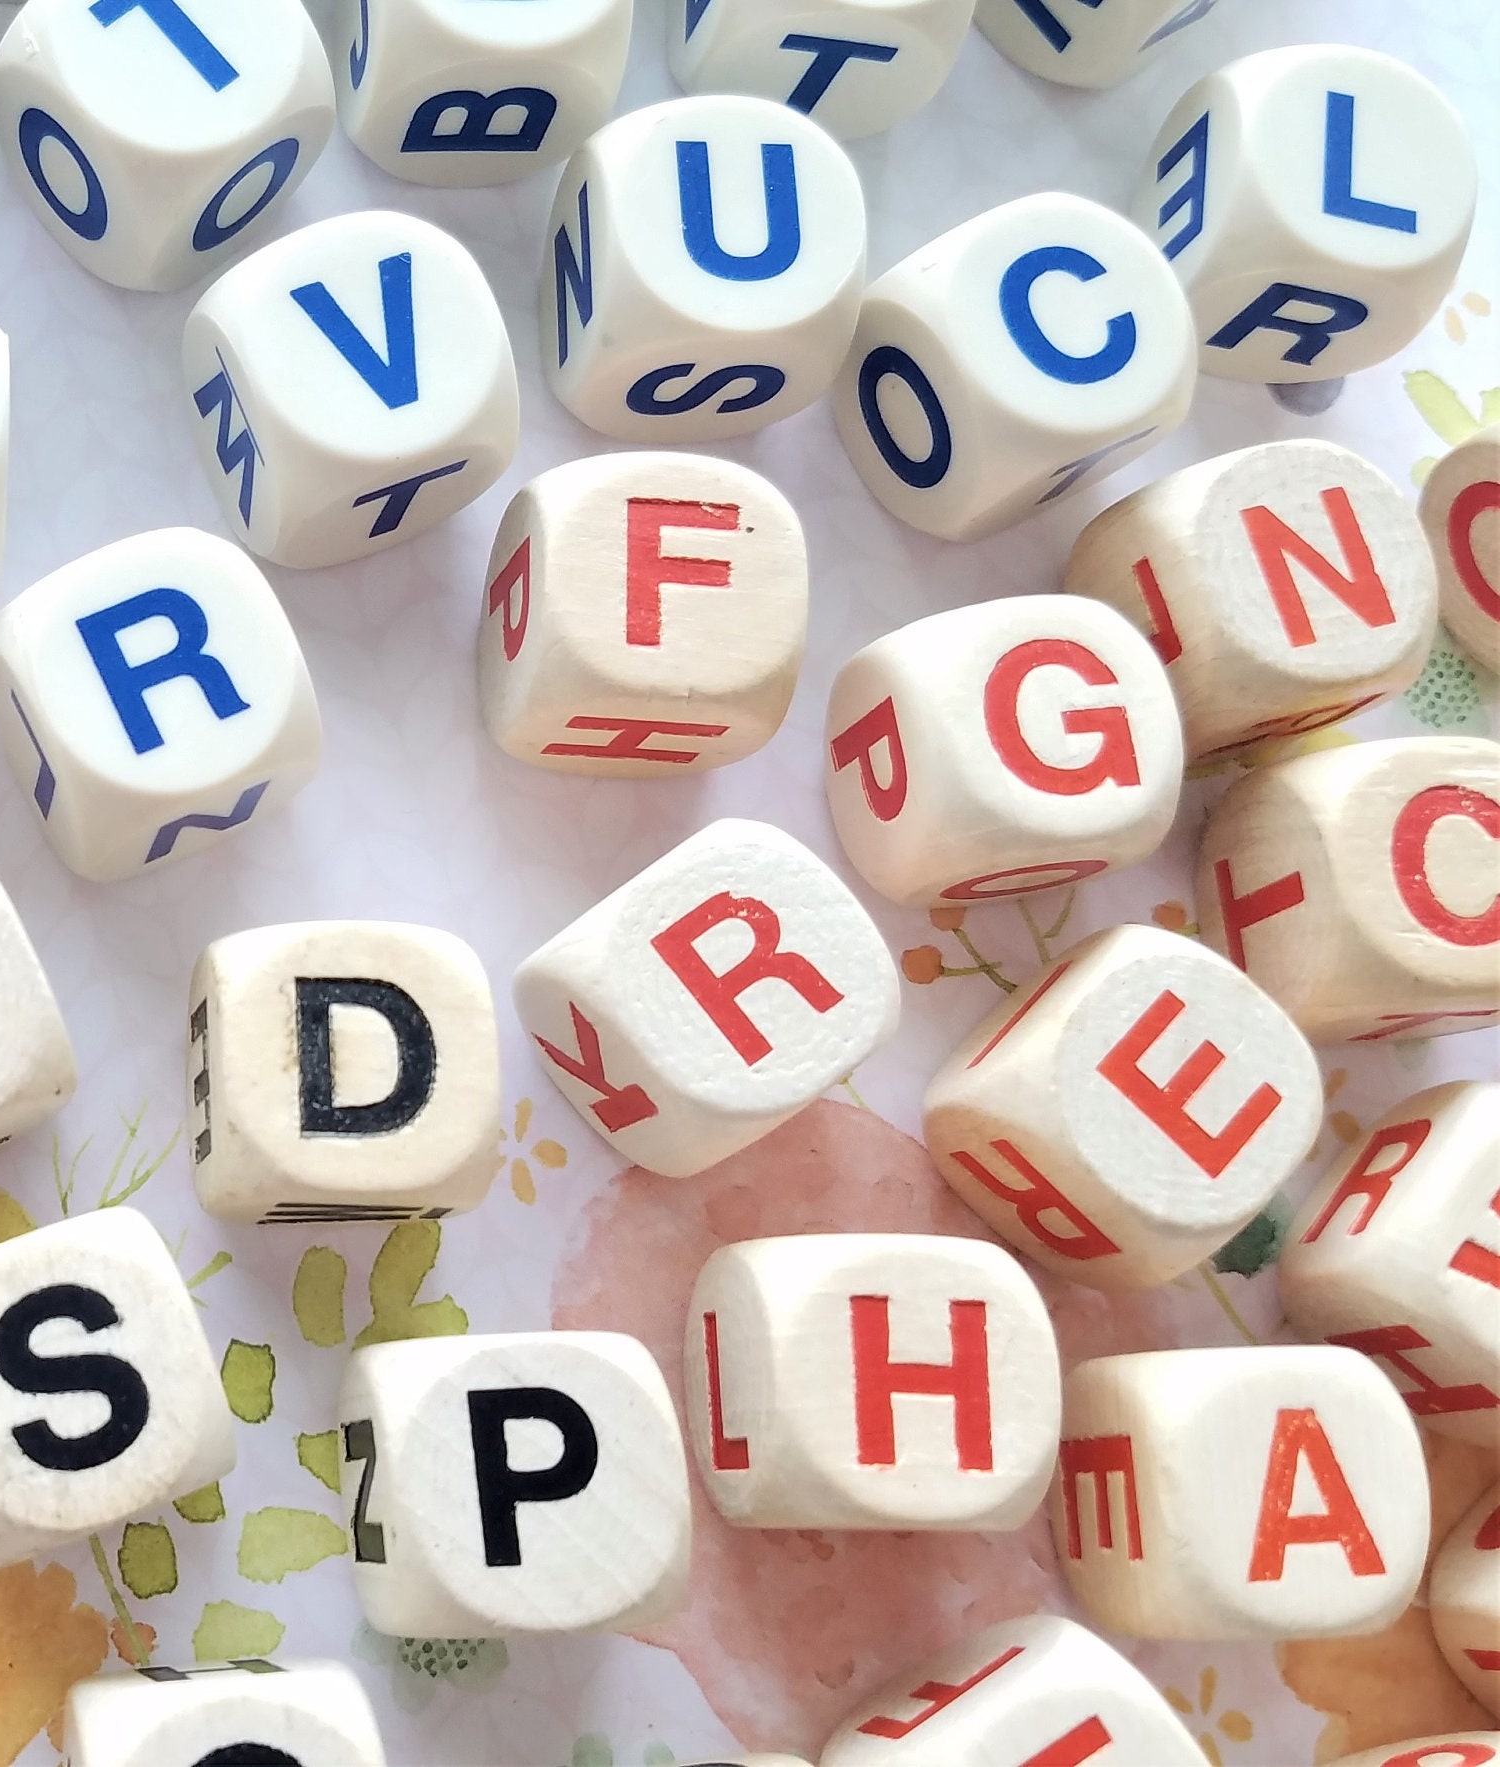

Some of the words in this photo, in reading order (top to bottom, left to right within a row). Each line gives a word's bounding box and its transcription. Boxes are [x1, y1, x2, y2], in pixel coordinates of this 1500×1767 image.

[401, 87, 557, 152] B
[780, 34, 898, 114] T
[19, 108, 107, 241] O
[192, 138, 299, 252] O
[676, 141, 800, 281] U
[1157, 111, 1209, 260] E
[1323, 91, 1417, 234] L
[290, 252, 418, 409] V
[554, 181, 592, 368] N
[999, 246, 1136, 384] C
[1207, 283, 1368, 365] R
[626, 363, 785, 415] S
[859, 346, 951, 488] O
[353, 460, 467, 538] T
[1241, 487, 1396, 647] N
[489, 537, 530, 661] P
[626, 497, 741, 646] F
[76, 588, 250, 754] R
[541, 716, 729, 764] H
[985, 639, 1141, 796] G
[831, 696, 907, 821] P
[651, 891, 844, 1066] R
[1214, 860, 1304, 972] T
[295, 977, 437, 1135] D
[534, 1001, 658, 1134] K
[1097, 990, 1282, 1178] E
[950, 1138, 1122, 1260] R
[1302, 1118, 1432, 1245] R
[703, 1312, 749, 1470] L
[849, 1295, 993, 1471] H
[467, 1387, 598, 1567] P
[1061, 1435, 1144, 1562] E
[1249, 1408, 1386, 1582] A
[856, 1646, 1026, 1740] F
